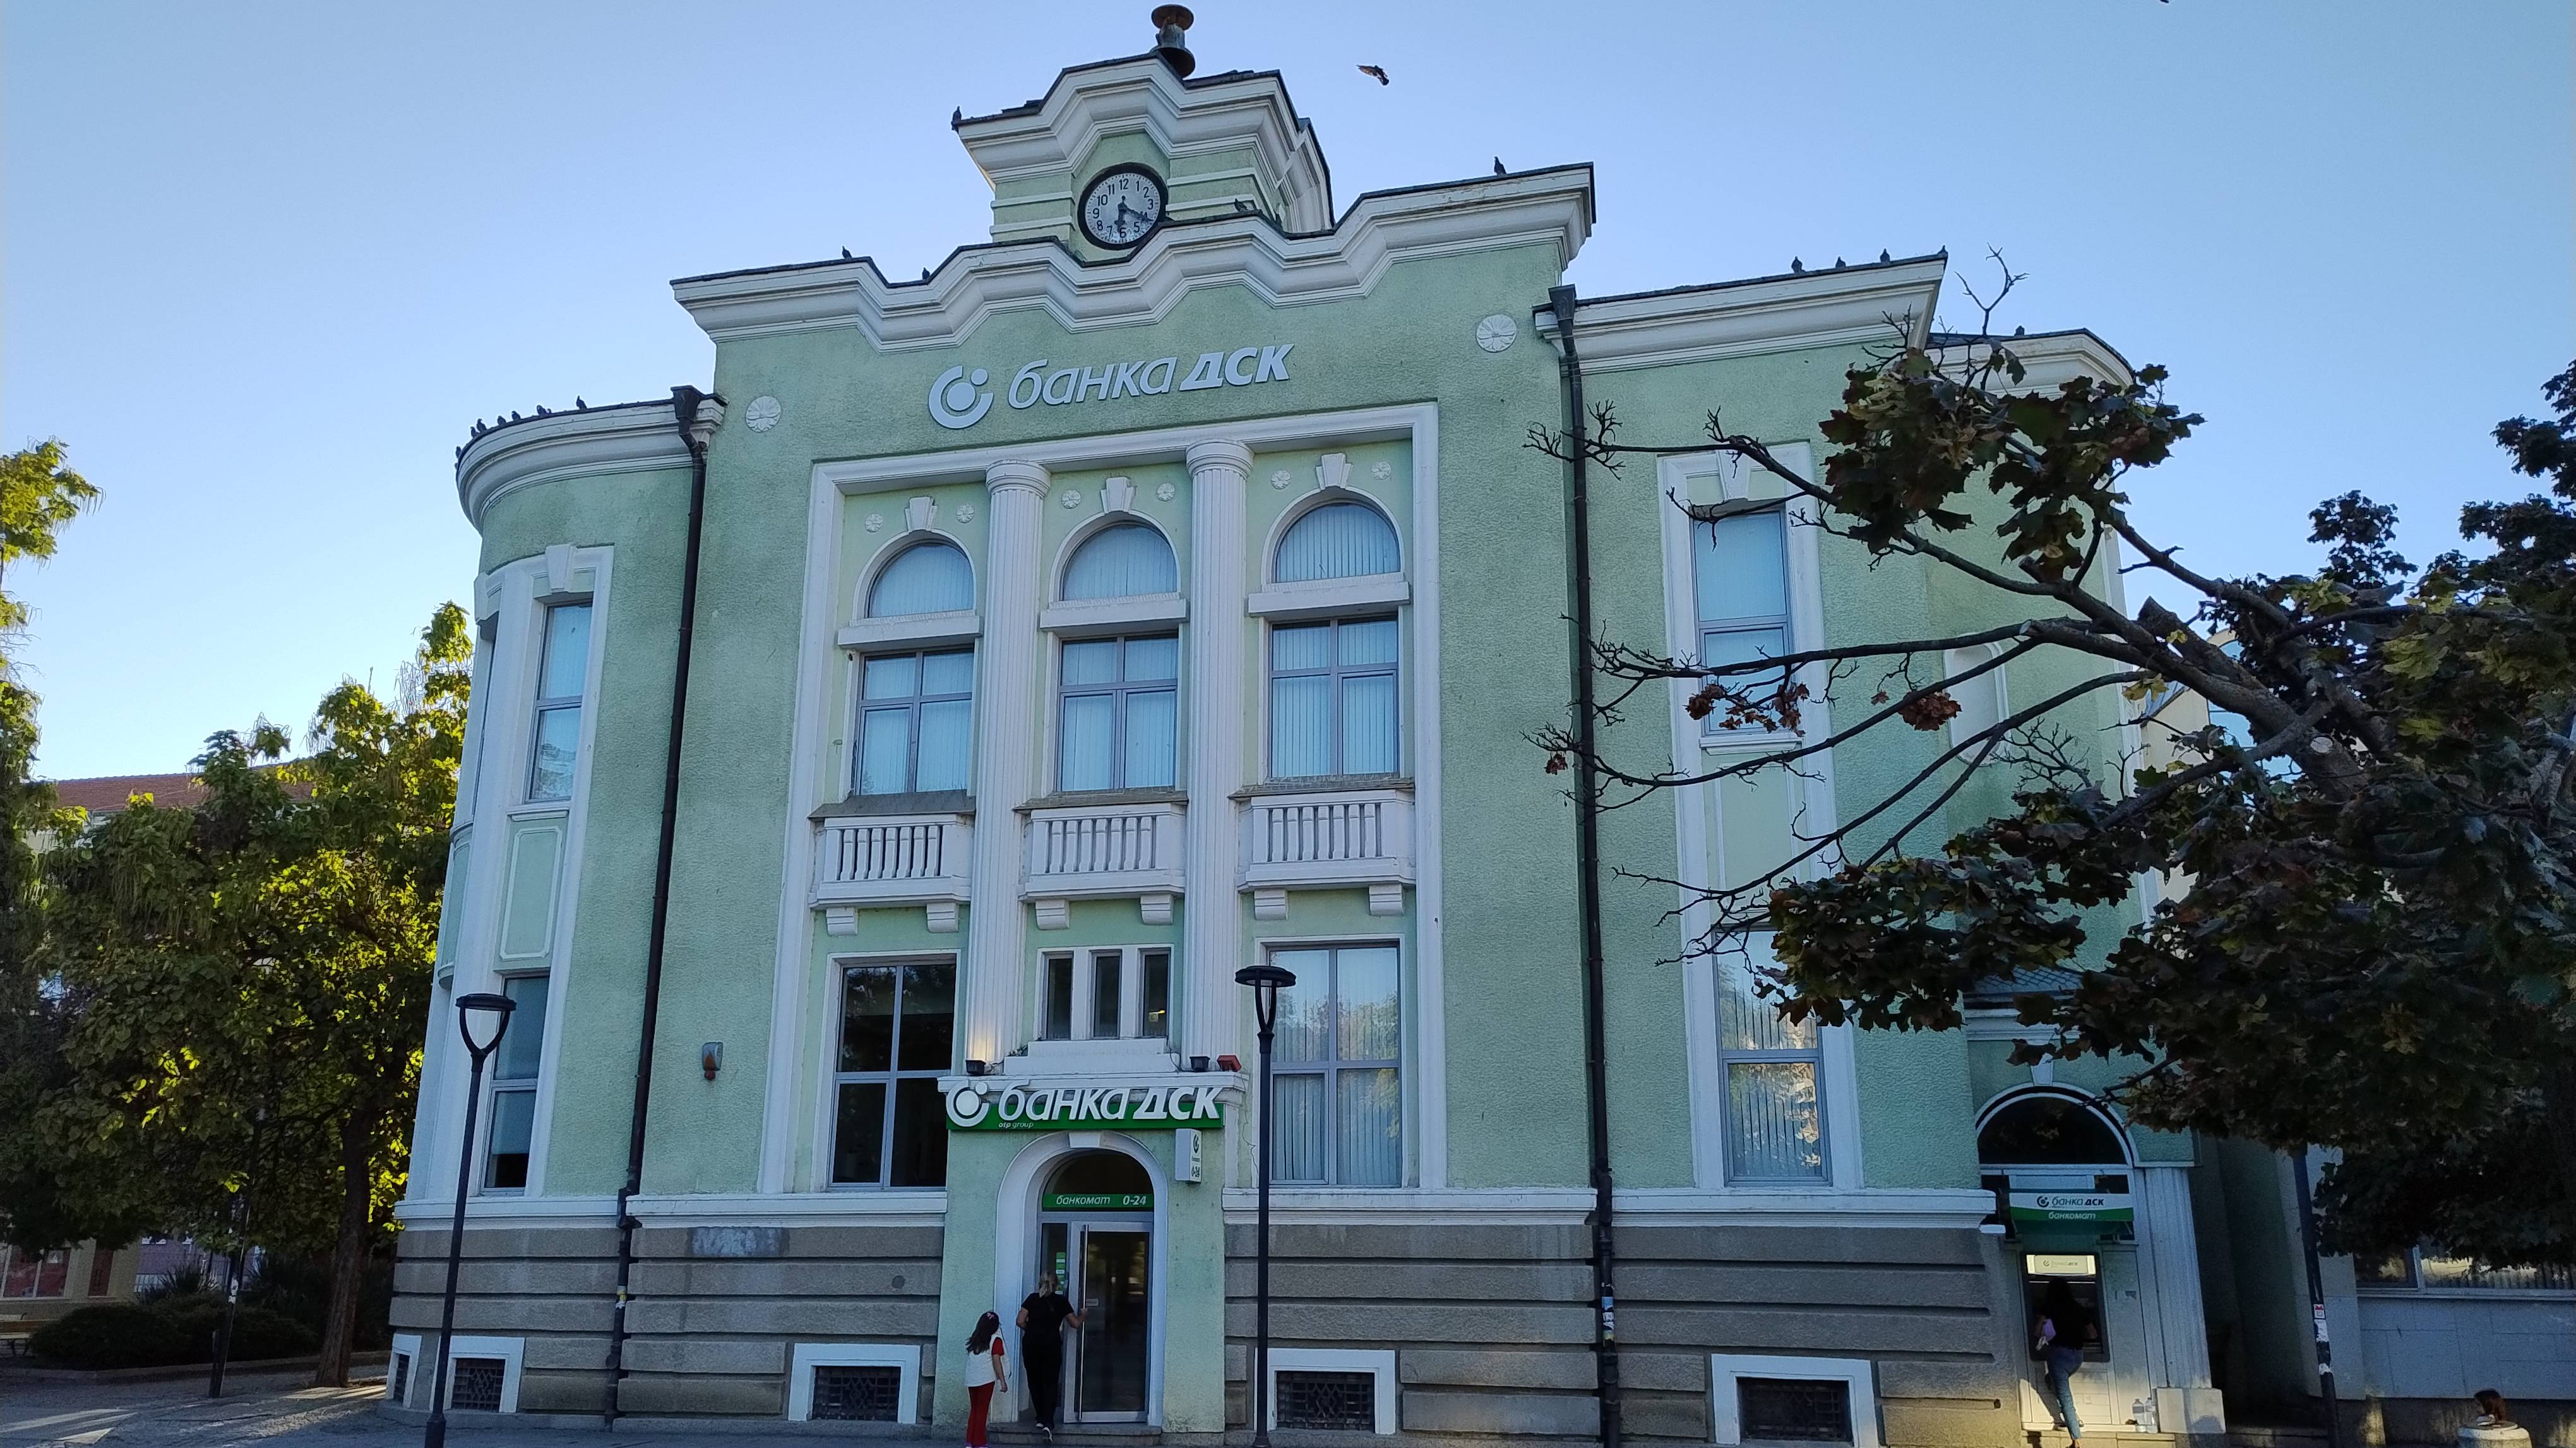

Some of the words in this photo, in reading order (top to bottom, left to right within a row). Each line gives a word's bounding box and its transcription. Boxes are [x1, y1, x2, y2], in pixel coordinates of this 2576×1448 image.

[1119, 178, 1129, 190] 12
[1135, 180, 1140, 192] 1
[1107, 184, 1115, 196] 11
[1143, 187, 1149, 198] 2
[1097, 194, 1107, 206] 10
[1148, 199, 1154, 210] 3
[1093, 208, 1100, 218] 9
[1097, 220, 1103, 230] 8
[1134, 222, 1140, 232] 5
[1107, 225, 1113, 238] 7
[1119, 227, 1126, 238] 6
[1008, 357, 1178, 409] банка
[998, 1079, 1129, 1121] банка
[1056, 1195, 1111, 1205] банкомат
[1123, 1195, 1147, 1206] 0-24
[2051, 1197, 2084, 1206] банка
[2048, 1211, 2096, 1219] банкомат
